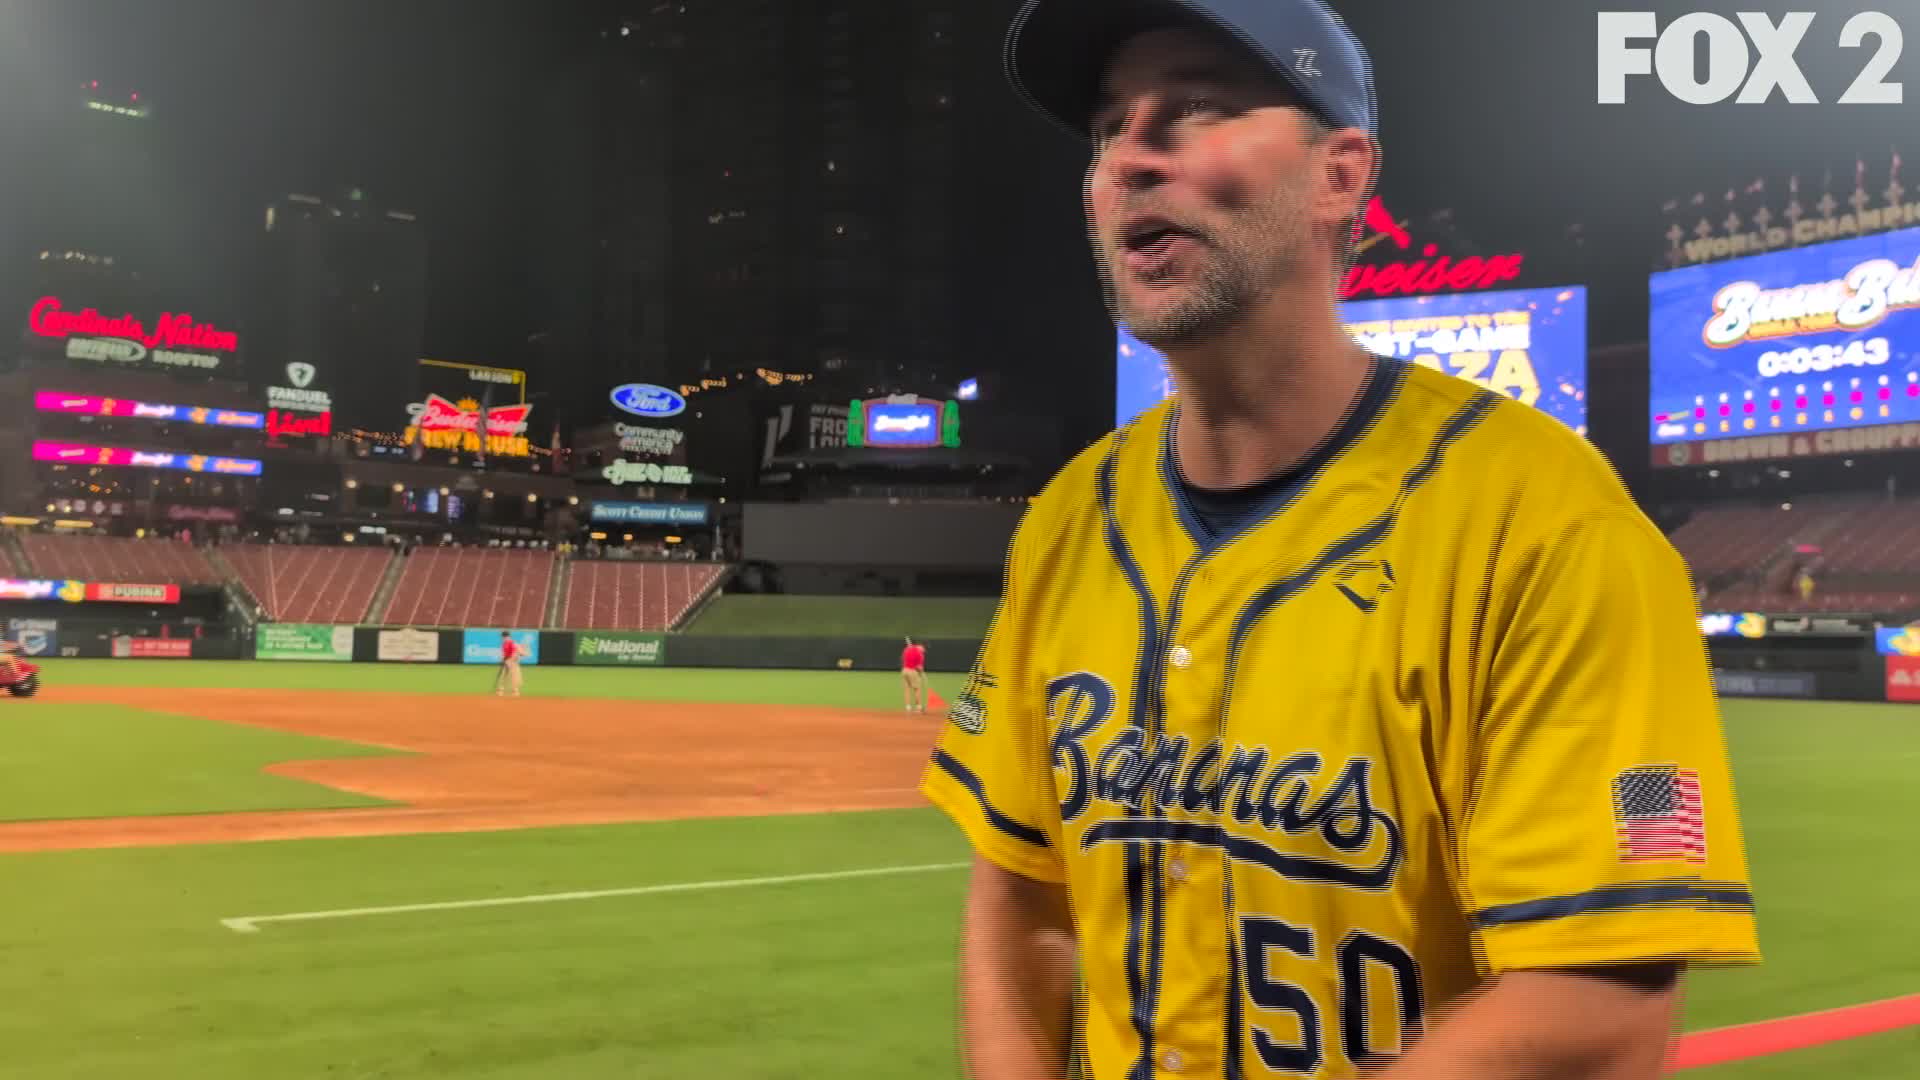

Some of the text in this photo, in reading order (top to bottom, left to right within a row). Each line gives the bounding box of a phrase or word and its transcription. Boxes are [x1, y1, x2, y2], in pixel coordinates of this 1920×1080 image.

[1685, 230, 1786, 262] WORLD
[29, 296, 143, 340] Cardinals
[143, 311, 238, 351] Nation
[1758, 337, 1889, 378] 0:03:43
[626, 387, 673, 413] Ford
[615, 422, 684, 445] Community
[597, 638, 660, 654] National
[1046, 671, 1396, 872] Bananas
[1240, 916, 1425, 1076] 50
